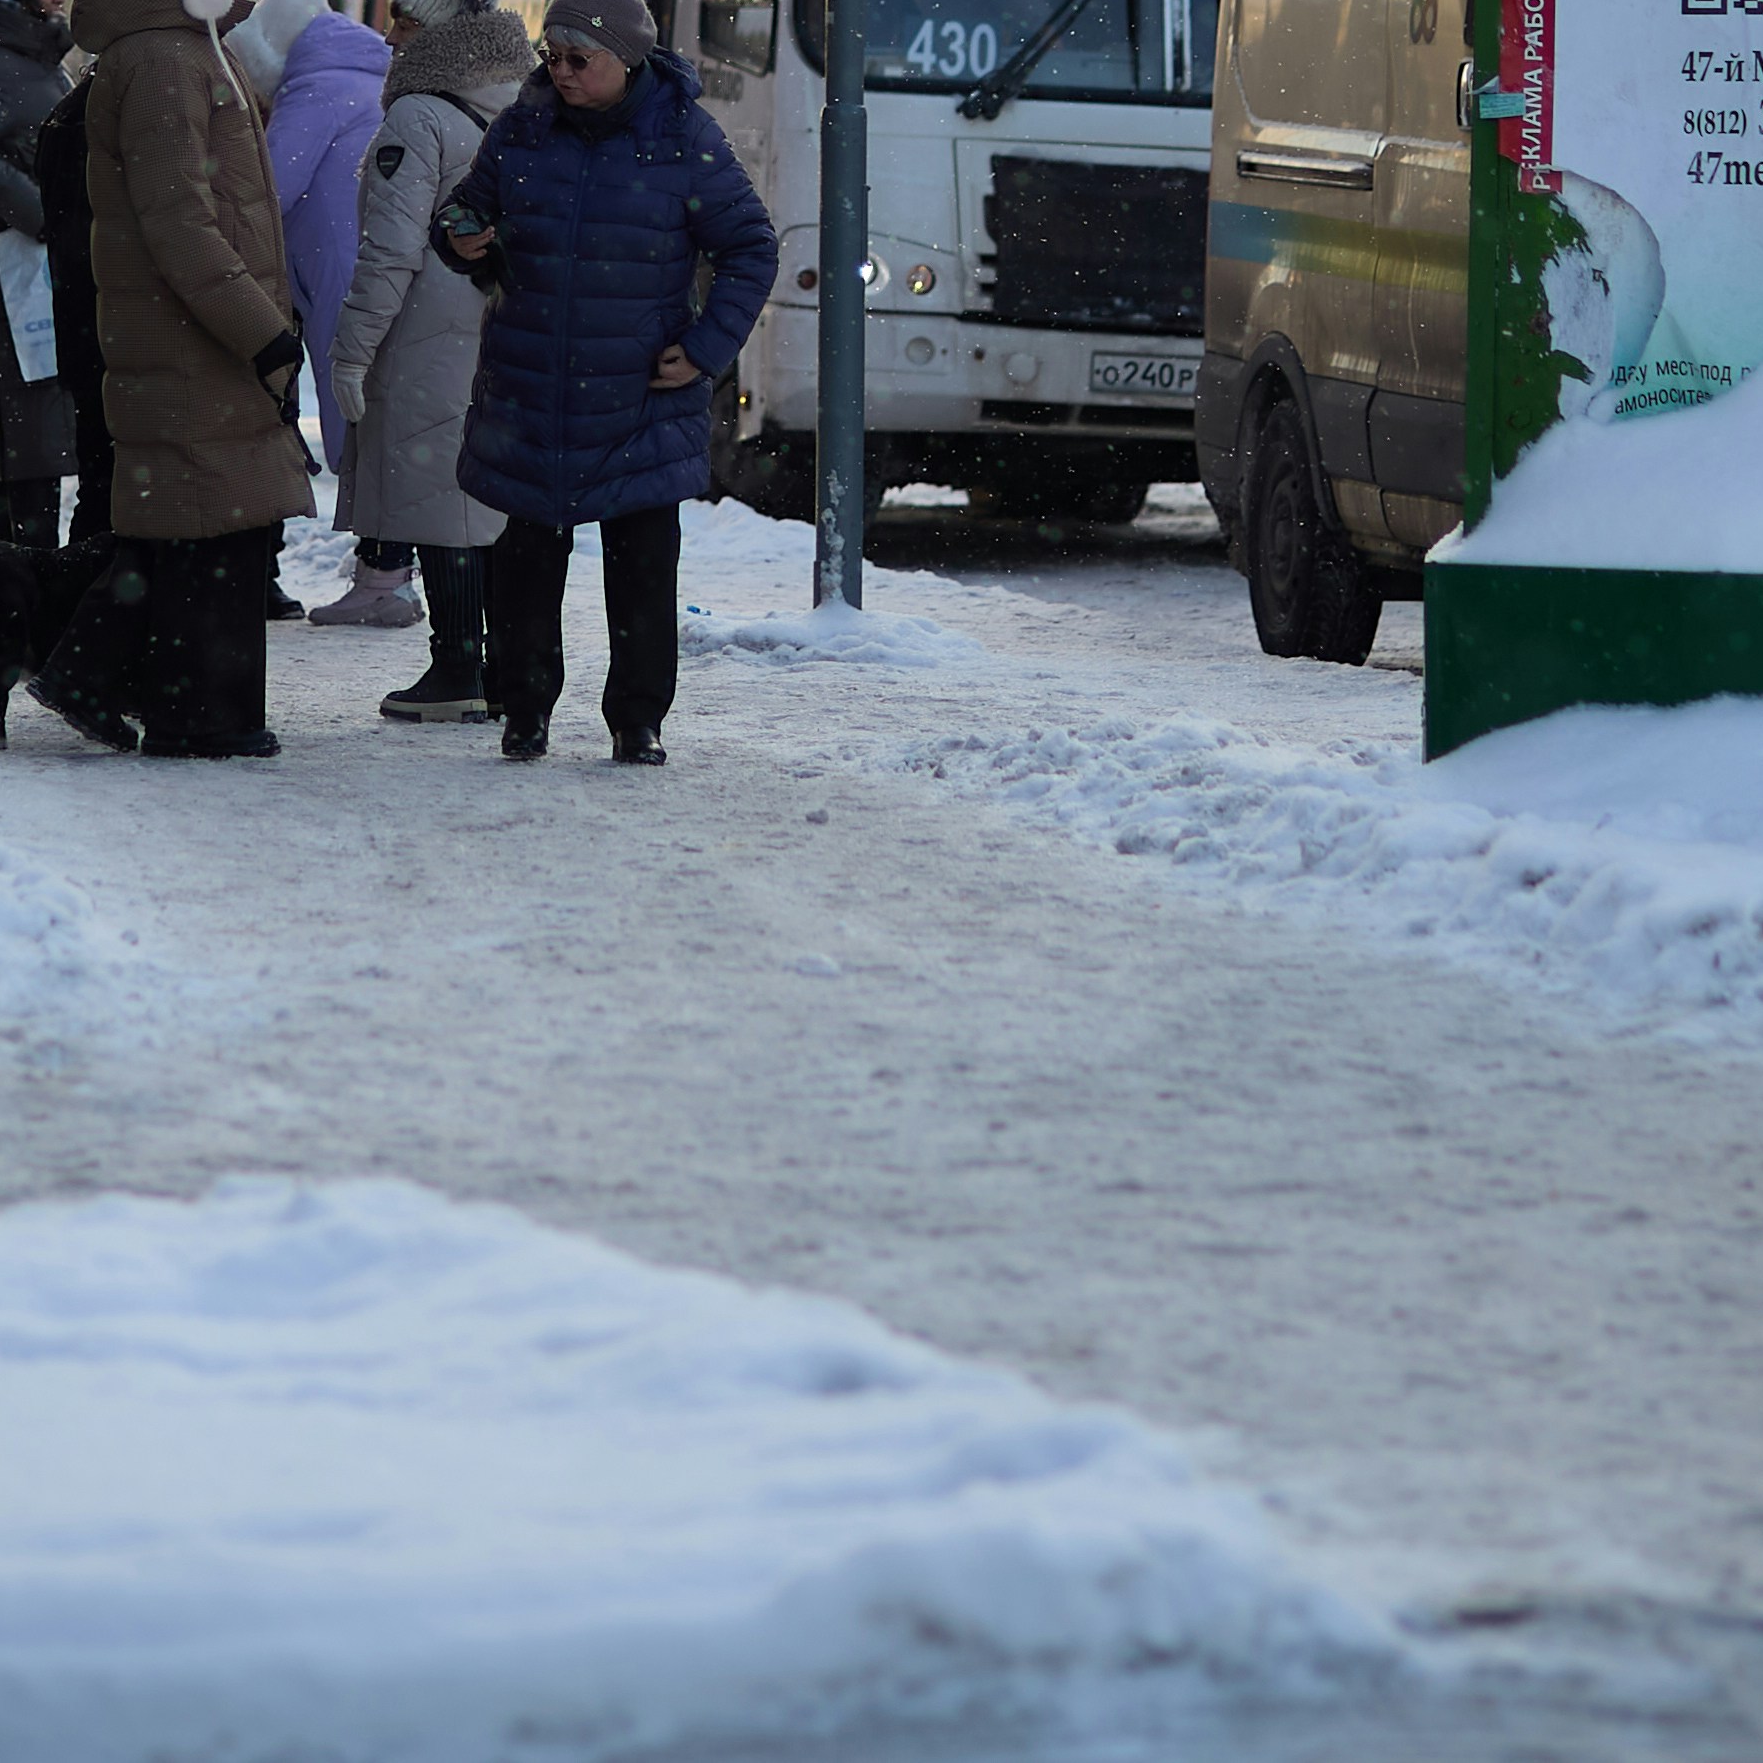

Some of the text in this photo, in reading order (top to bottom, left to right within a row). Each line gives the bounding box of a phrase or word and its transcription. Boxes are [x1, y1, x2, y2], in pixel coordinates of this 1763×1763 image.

[907, 19, 998, 78] 430
[1681, 50, 1745, 83] 47-й
[1683, 108, 1748, 138] 8(812)
[1103, 360, 1195, 389] О240Р
[1656, 359, 1695, 378] мест
[1700, 364, 1732, 386] под
[1614, 388, 1714, 415] амоносите
